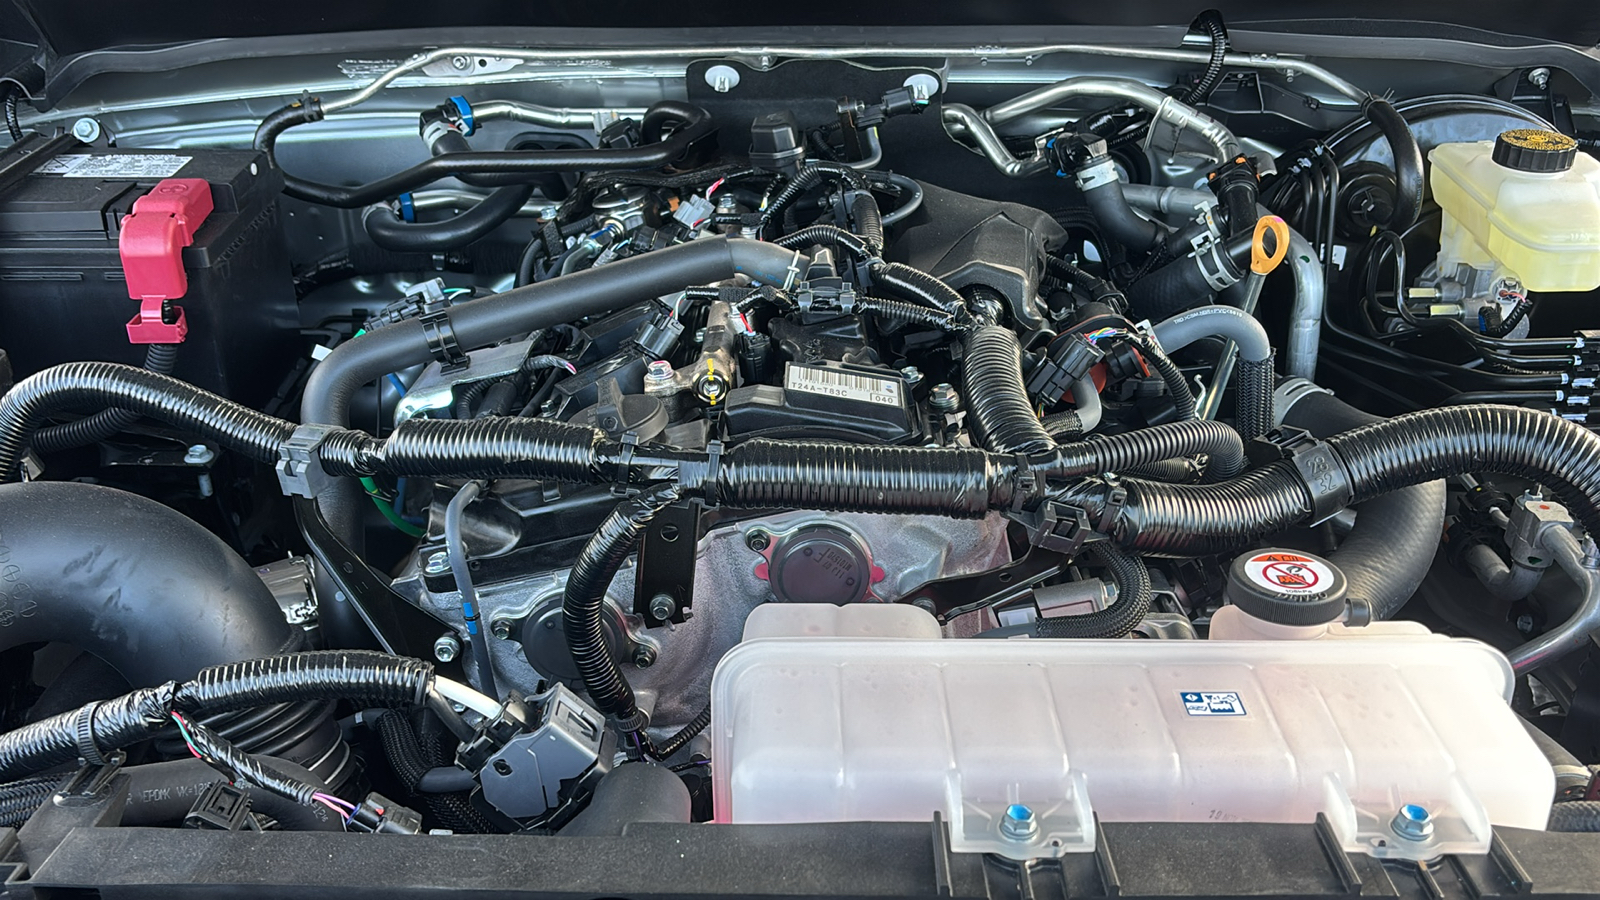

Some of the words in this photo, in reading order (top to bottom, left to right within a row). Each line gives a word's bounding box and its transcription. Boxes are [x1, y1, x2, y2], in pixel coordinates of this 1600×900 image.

[875, 394, 894, 404] 040
[1305, 455, 1329, 477] 28
[1314, 472, 1338, 495] 32
